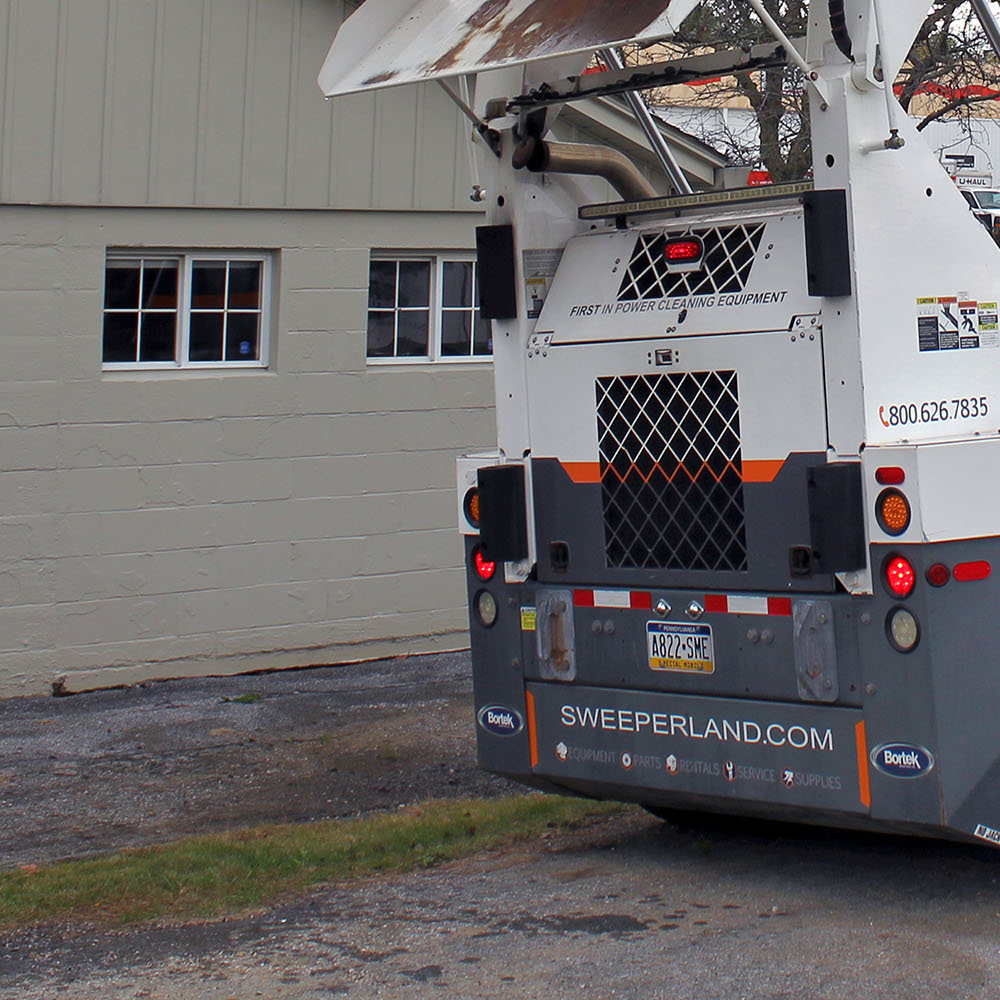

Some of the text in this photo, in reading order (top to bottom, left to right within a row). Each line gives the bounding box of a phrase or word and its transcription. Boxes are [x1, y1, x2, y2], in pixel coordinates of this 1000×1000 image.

[569, 291, 788, 317] FIRST IN POWER CLEANING EQUIPMENT
[889, 397, 988, 426] 800.626.7835
[487, 711, 514, 729] Bortek
[560, 705, 834, 750] SWEEPERLAND.COM
[568, 747, 842, 790] EQUIPMENT PARTS RENTALS SERVICE SUPPLIES
[883, 750, 921, 769] Bortek
